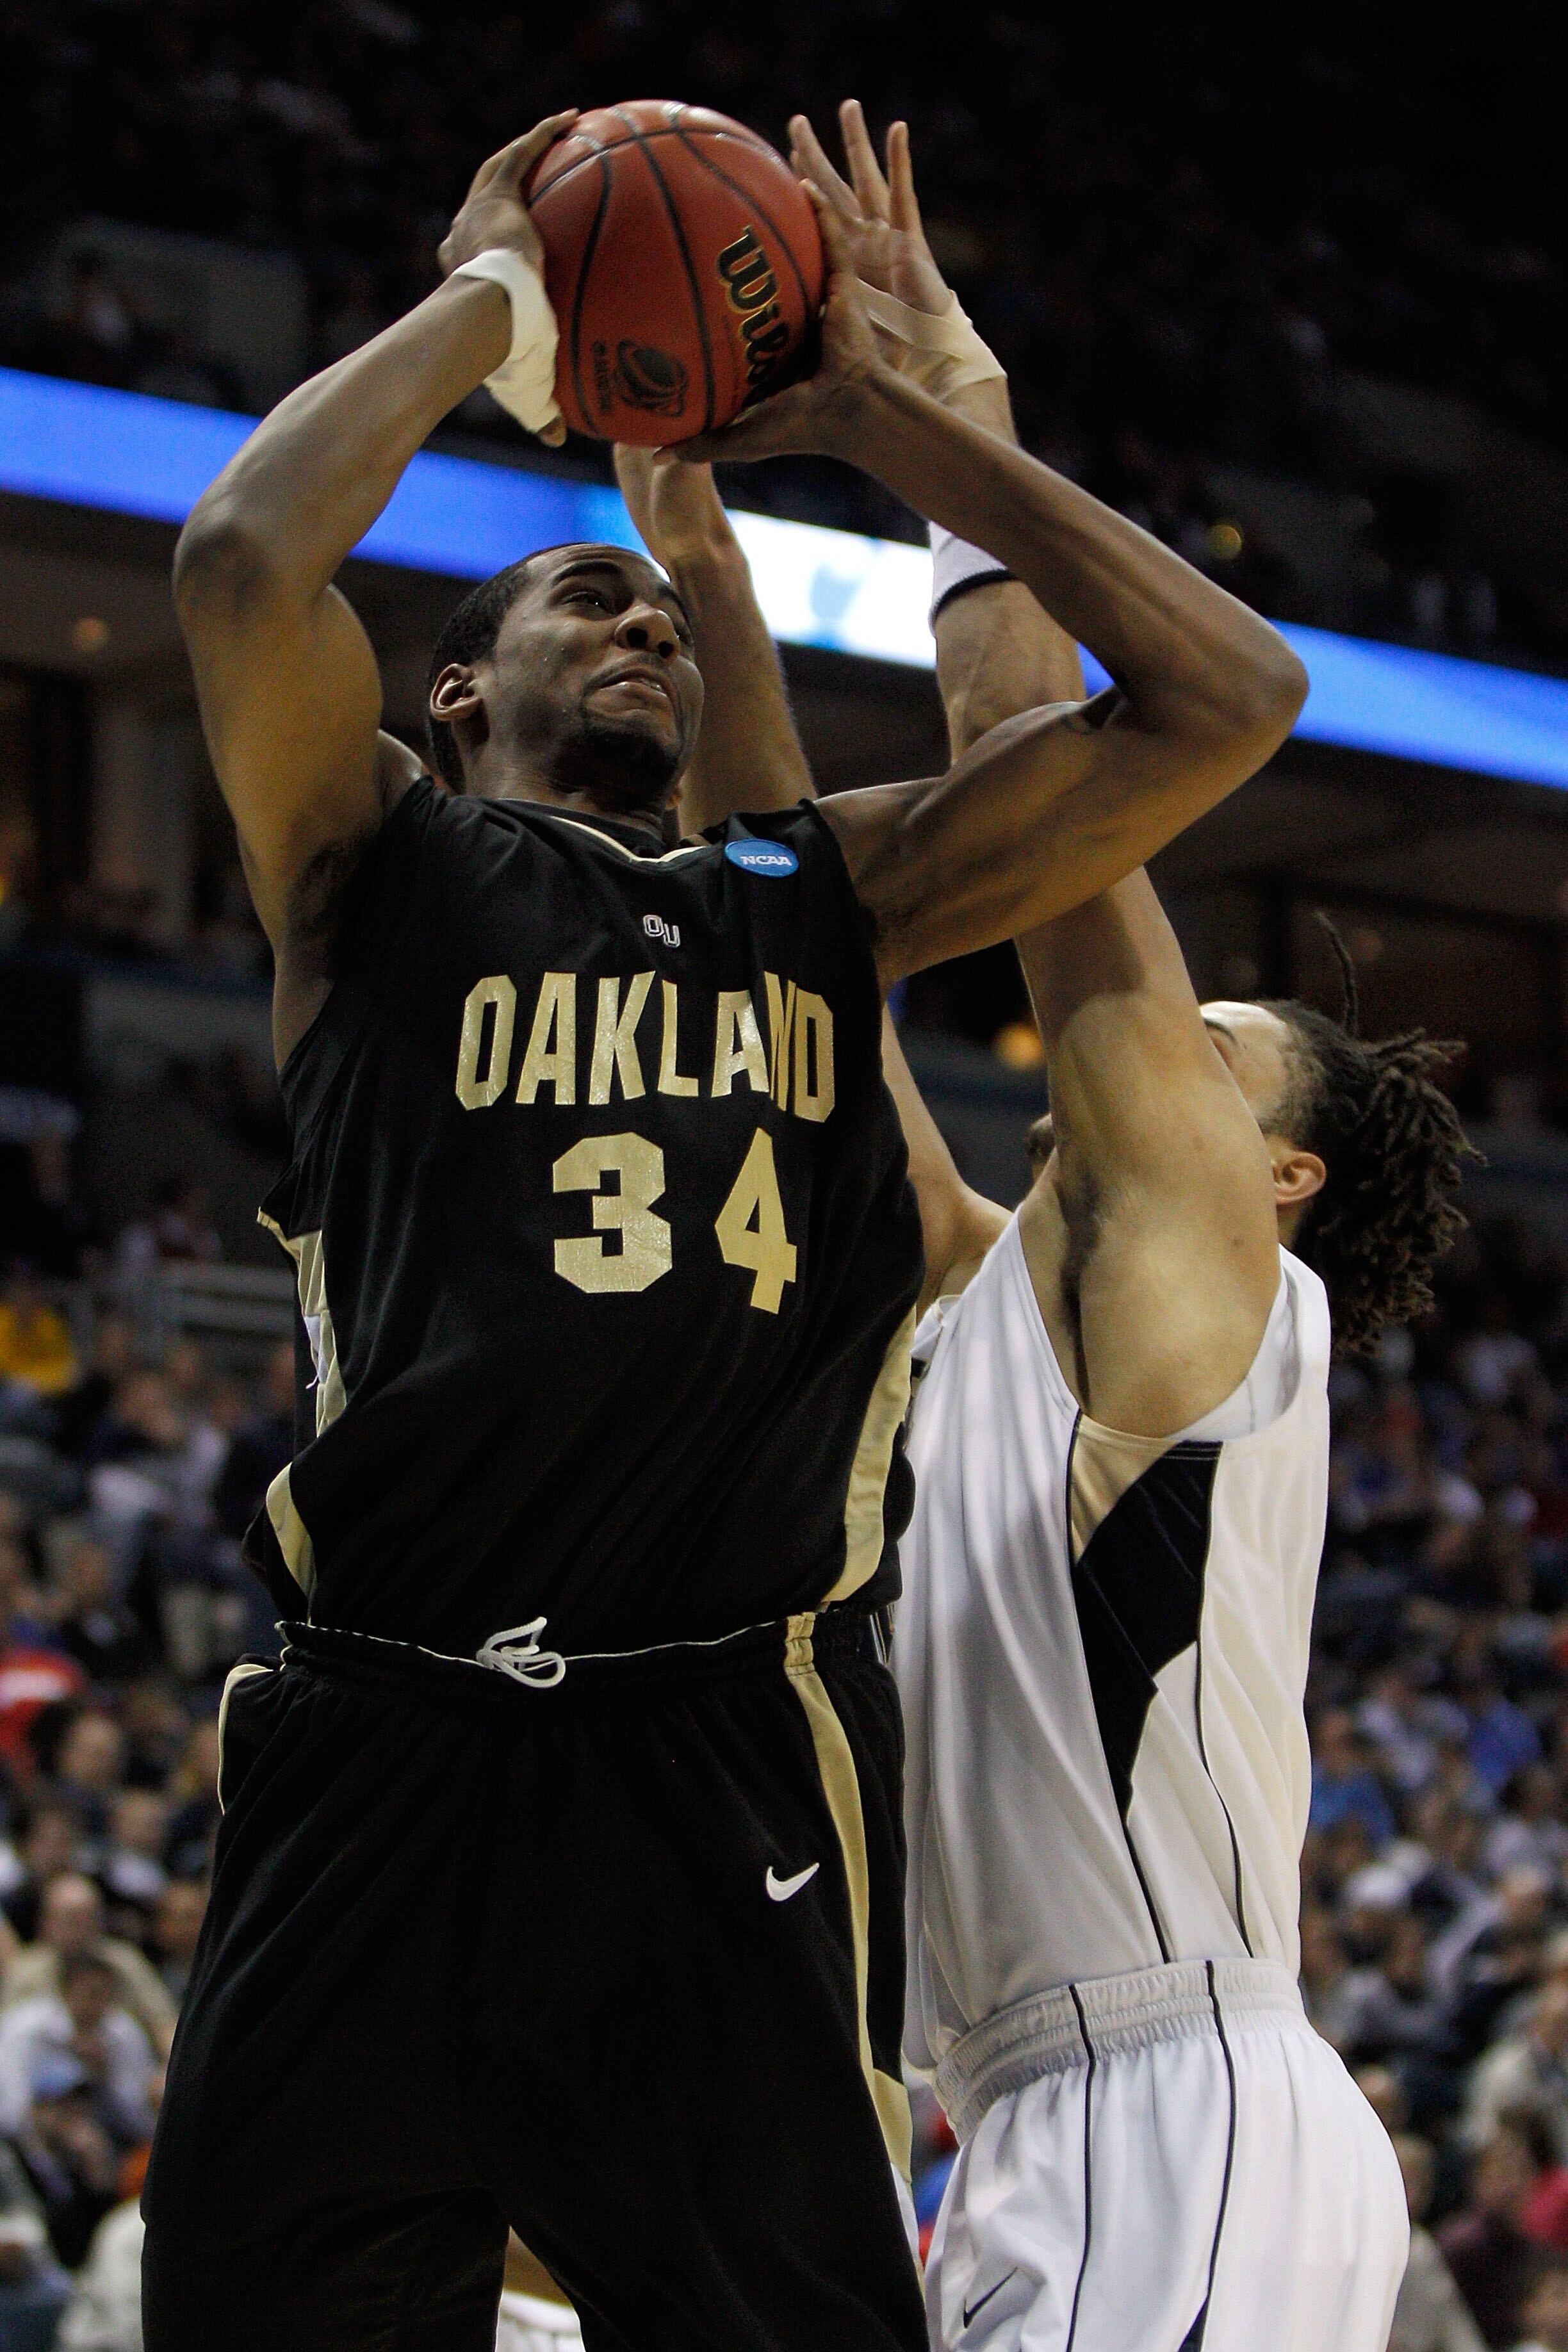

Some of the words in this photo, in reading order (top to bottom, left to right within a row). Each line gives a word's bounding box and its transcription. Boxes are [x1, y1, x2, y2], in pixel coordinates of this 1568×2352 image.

[740, 855, 793, 866] NCAA
[643, 914, 681, 948] OU
[455, 970, 836, 1123] OAKLAND
[552, 1127, 797, 1315] 34
